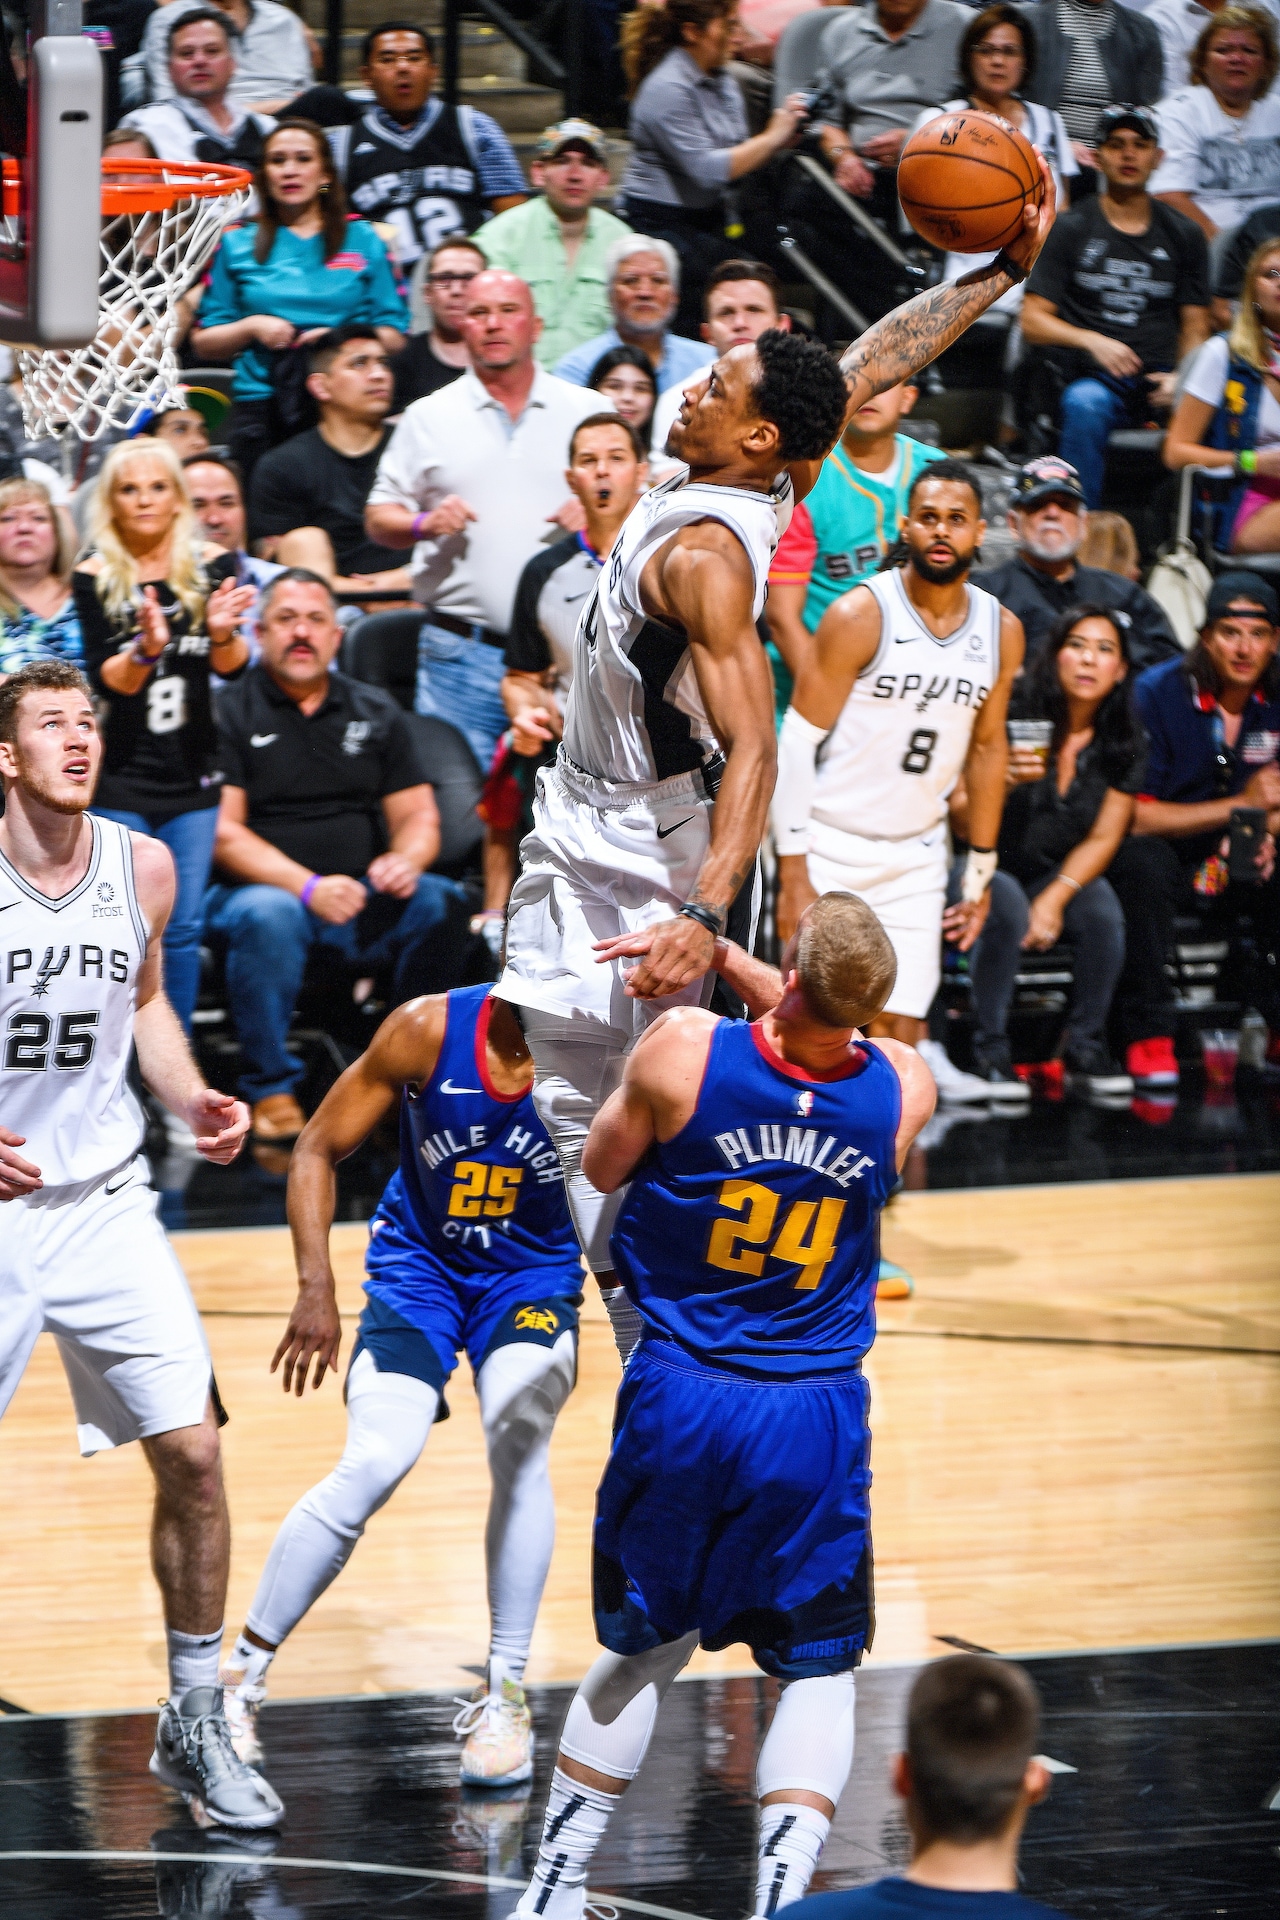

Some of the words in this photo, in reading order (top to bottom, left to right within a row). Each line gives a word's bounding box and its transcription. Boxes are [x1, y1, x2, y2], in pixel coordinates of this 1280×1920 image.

[146, 674, 186, 735] 8
[873, 674, 989, 713] SPURS
[901, 728, 939, 775] 8
[91, 903, 124, 919] Frost
[2, 944, 129, 1000] PURS
[2, 1009, 101, 1072] 25
[419, 1124, 488, 1170] MILE
[504, 1124, 564, 1184] HIGH
[714, 1124, 878, 1188] PLUMLEE
[446, 1160, 525, 1218] 25
[705, 1179, 850, 1291] 24
[790, 1631, 866, 1661] NUGGETS
